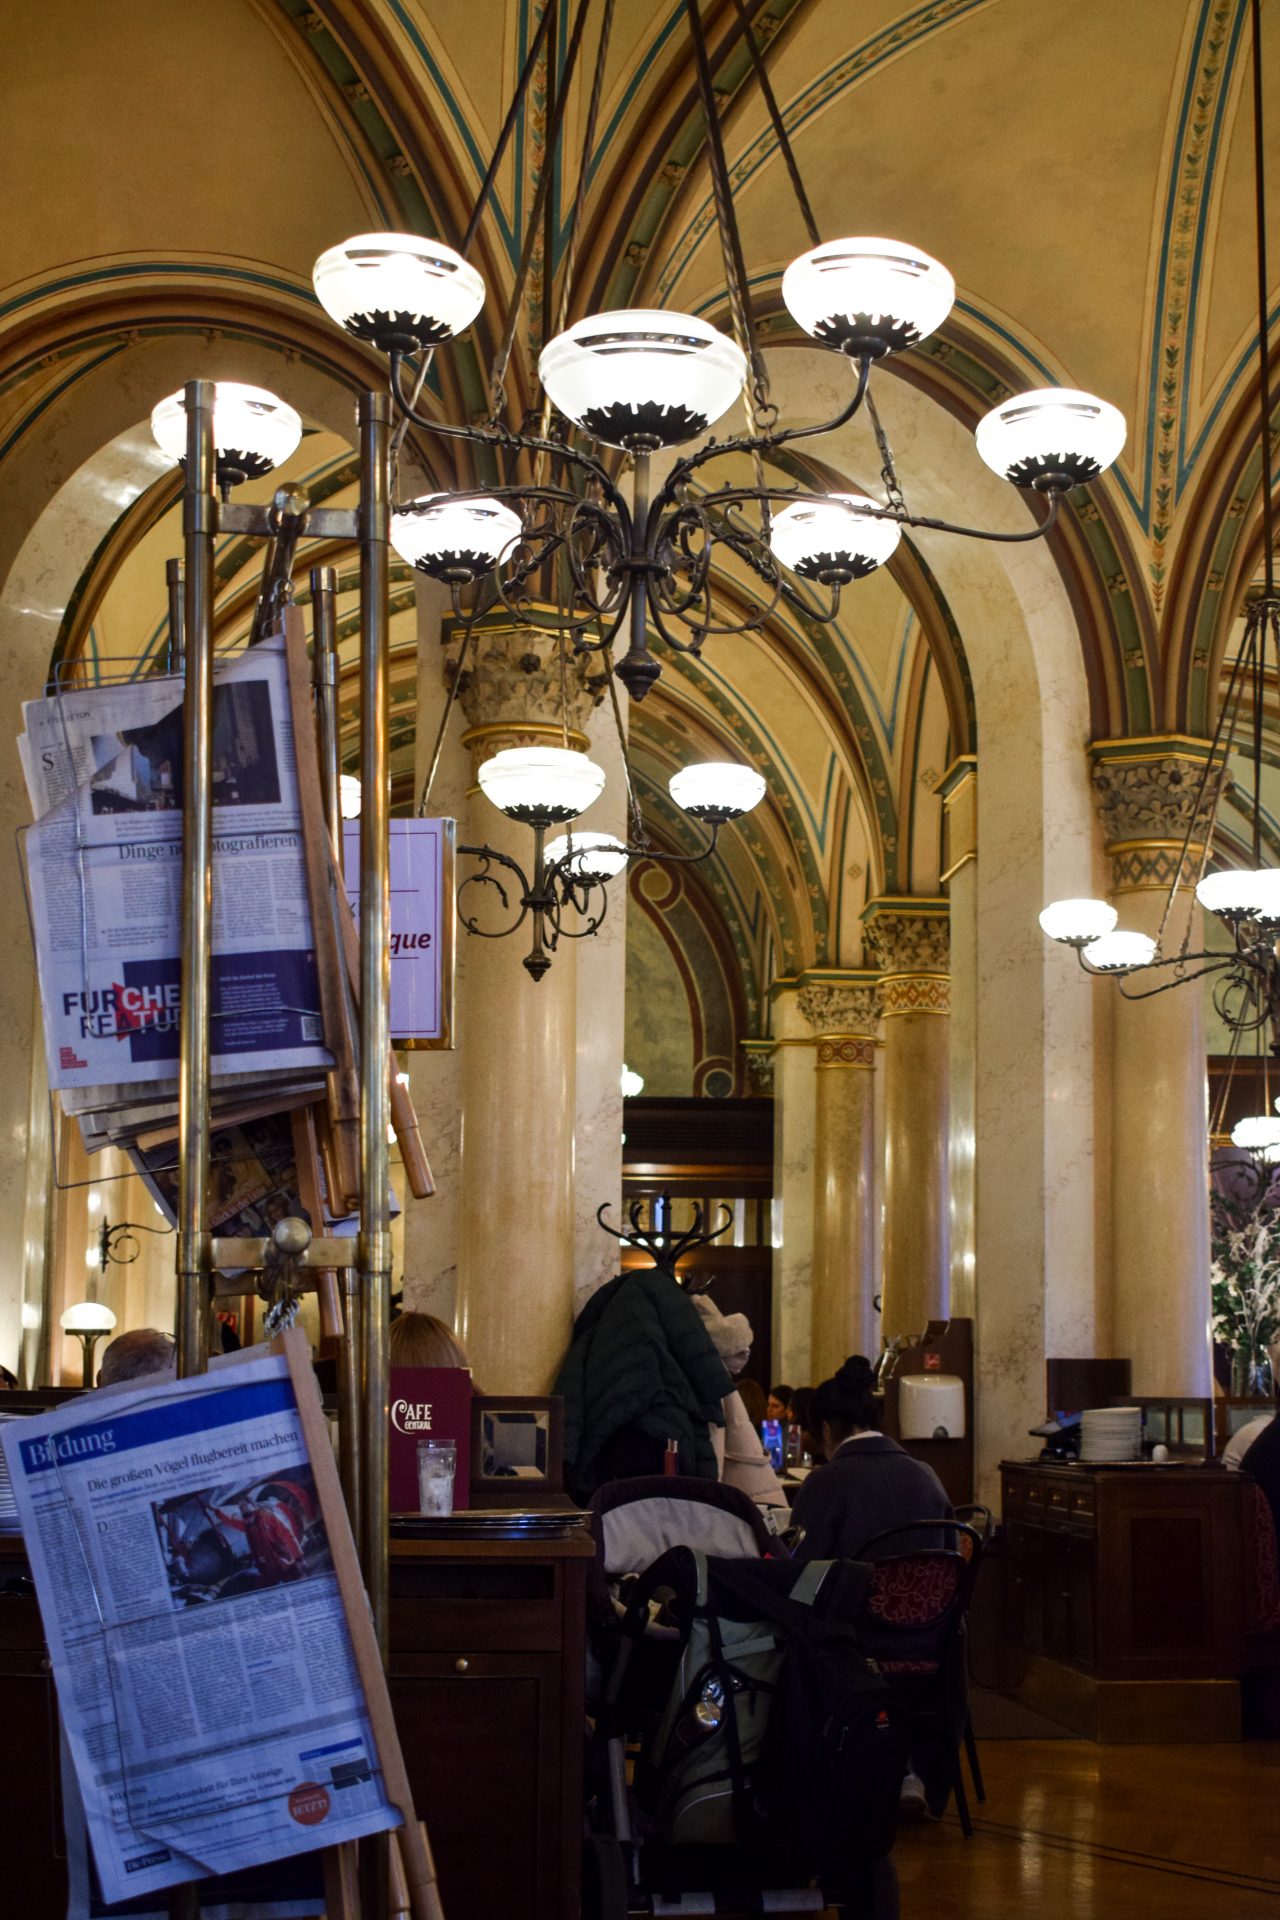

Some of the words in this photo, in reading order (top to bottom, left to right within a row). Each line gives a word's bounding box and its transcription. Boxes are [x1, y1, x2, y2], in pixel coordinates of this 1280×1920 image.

[119, 842, 164, 861] Dinge
[211, 833, 297, 855] otografieren
[390, 932, 432, 955] que
[80, 1008, 181, 1039] FEATU
[404, 1420, 432, 1430] CENTRAL
[29, 1429, 117, 1466] Bildung
[87, 1479, 109, 1492] Die
[111, 1468, 153, 1489] großen
[154, 1455, 189, 1474] Vögel
[190, 1442, 249, 1466] flugbereit
[250, 1431, 299, 1452] machen
